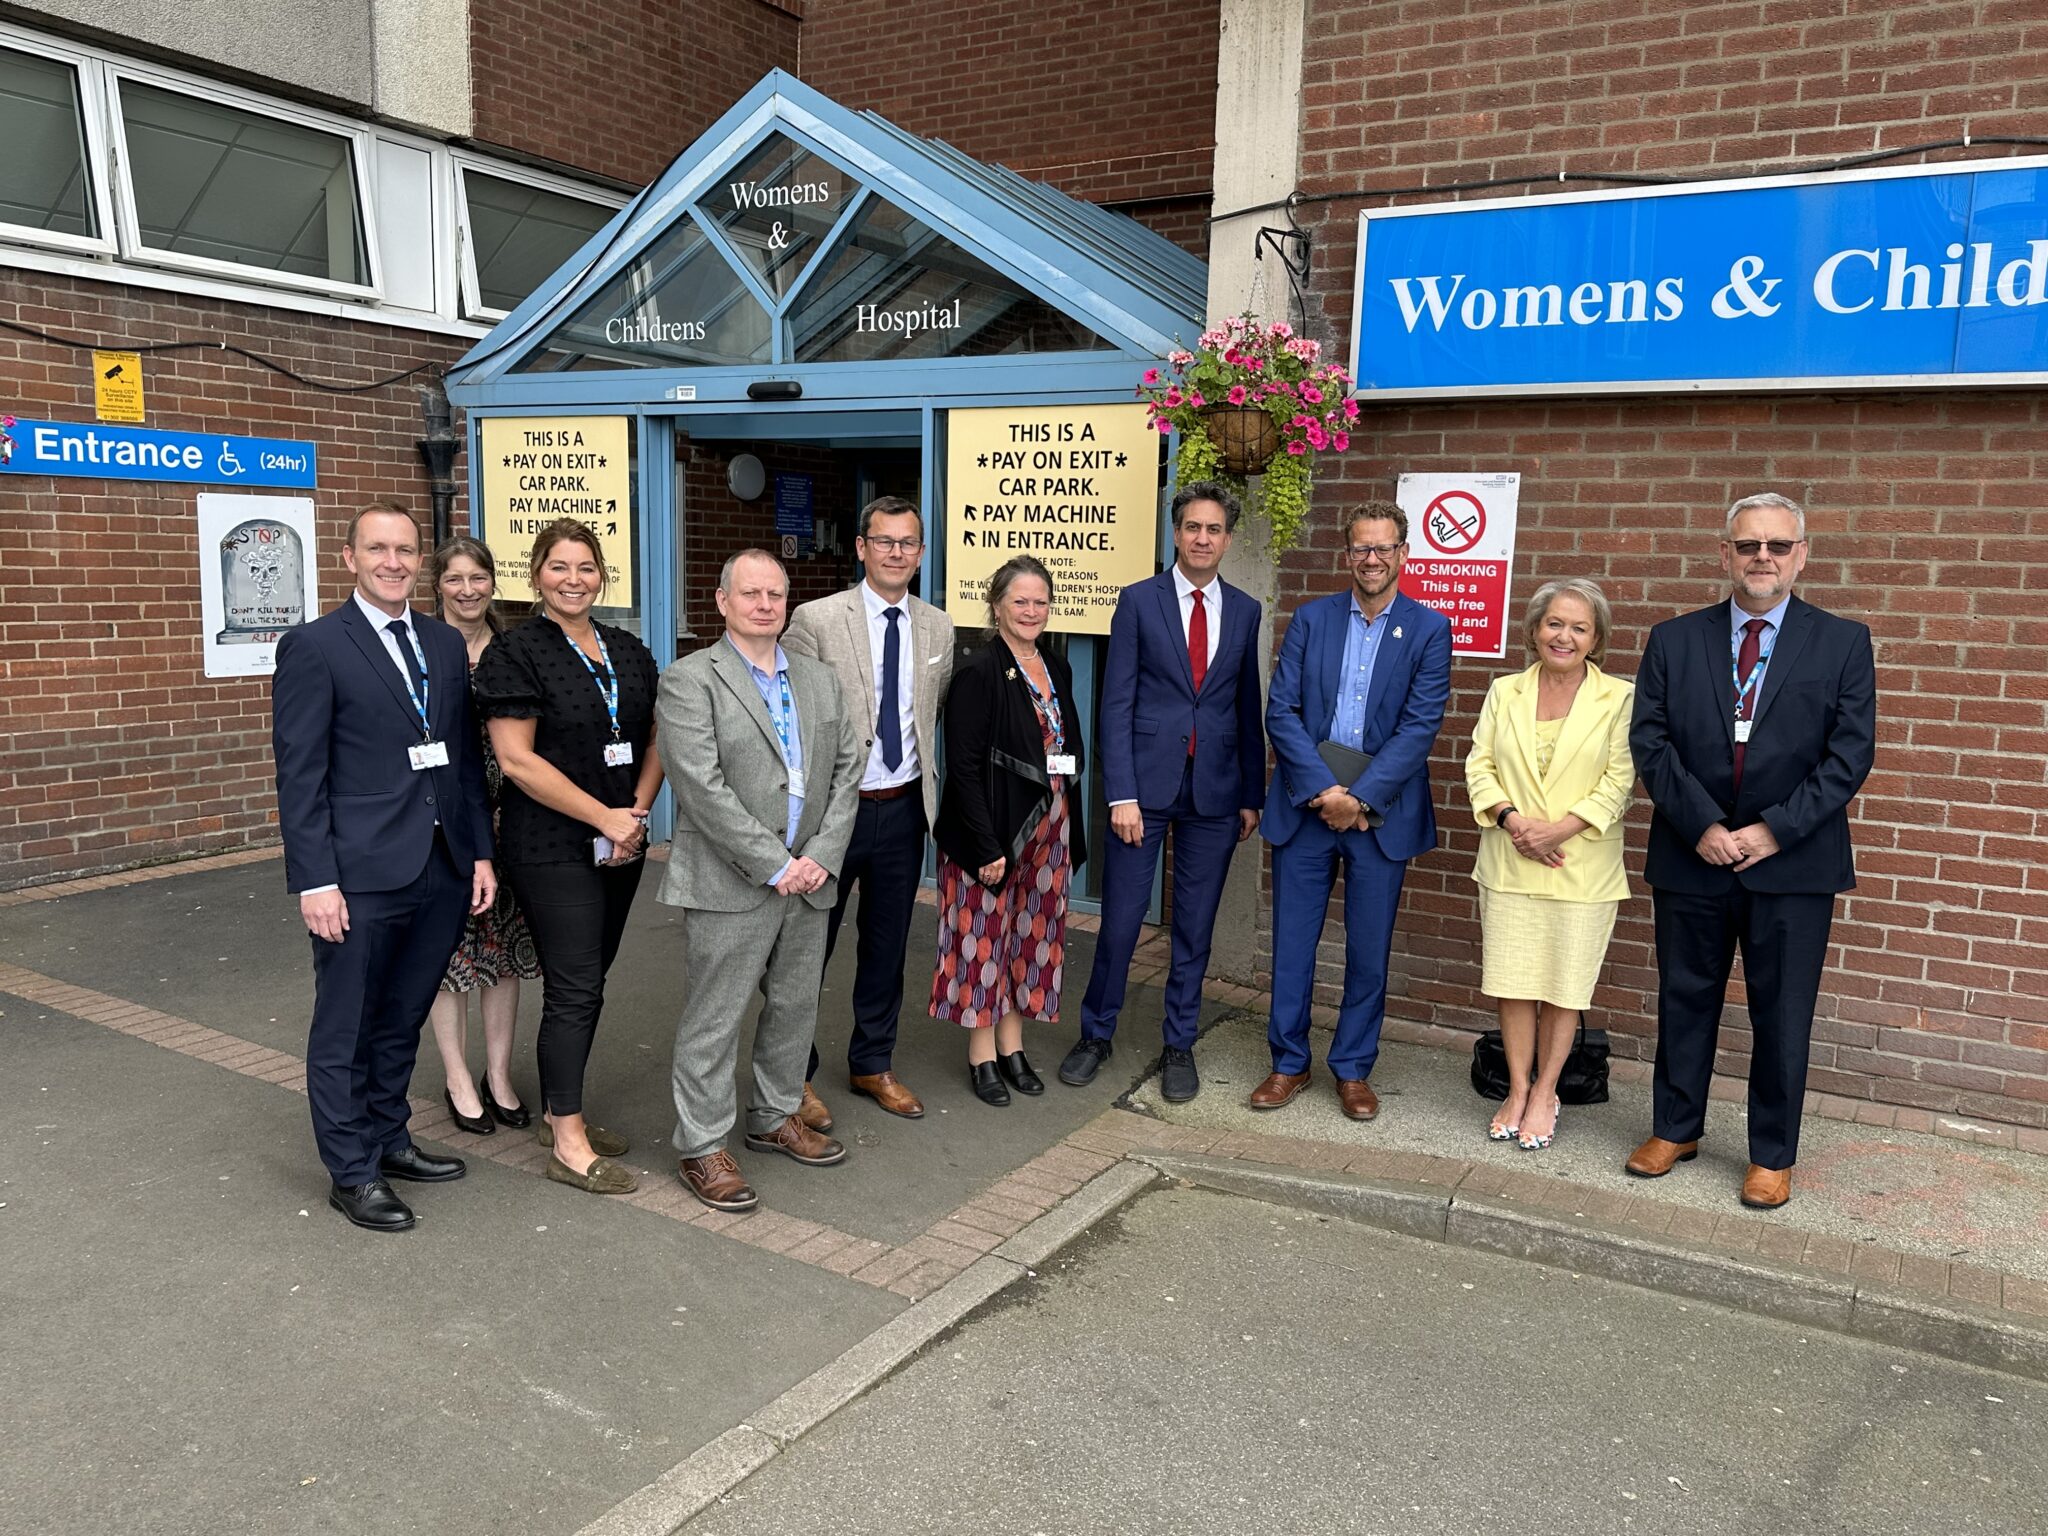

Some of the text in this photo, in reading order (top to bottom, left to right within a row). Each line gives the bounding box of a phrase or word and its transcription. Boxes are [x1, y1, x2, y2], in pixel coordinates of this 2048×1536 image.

[730, 180, 829, 210] Womens
[767, 221, 789, 249] &
[1390, 273, 1684, 333] Womens
[1711, 255, 1783, 319] &
[856, 299, 961, 338] Hospital
[605, 315, 706, 344] Childrens
[524, 431, 584, 447] THIS IS A
[1009, 423, 1095, 442] THIS IS A
[34, 427, 307, 473] Entrance (24hr)
[542, 454, 562, 469] ON
[1033, 451, 1062, 469] ON
[519, 476, 590, 491] CAR PARK.
[999, 478, 1099, 495] CAR PARK.
[509, 498, 602, 514] PAY MACHINE
[984, 505, 1116, 523] PAY MACHINE
[510, 519, 523, 534] IN
[983, 531, 1115, 551] IN ENTRANCE.
[1050, 558, 1076, 566] NOTE:
[1057, 572, 1098, 580] REASONS
[1405, 563, 1497, 577] NO SMOKING
[960, 580, 974, 588] THE
[1053, 584, 1093, 593] ILDREN'S
[1421, 580, 1478, 593] This is a
[960, 592, 978, 600] WILL
[1072, 596, 1089, 605] THE
[1091, 597, 1117, 606] HOUR
[1459, 598, 1485, 611] free
[1064, 607, 1087, 617] 6AM.
[1462, 617, 1488, 628] and
[252, 632, 278, 644] RIP
